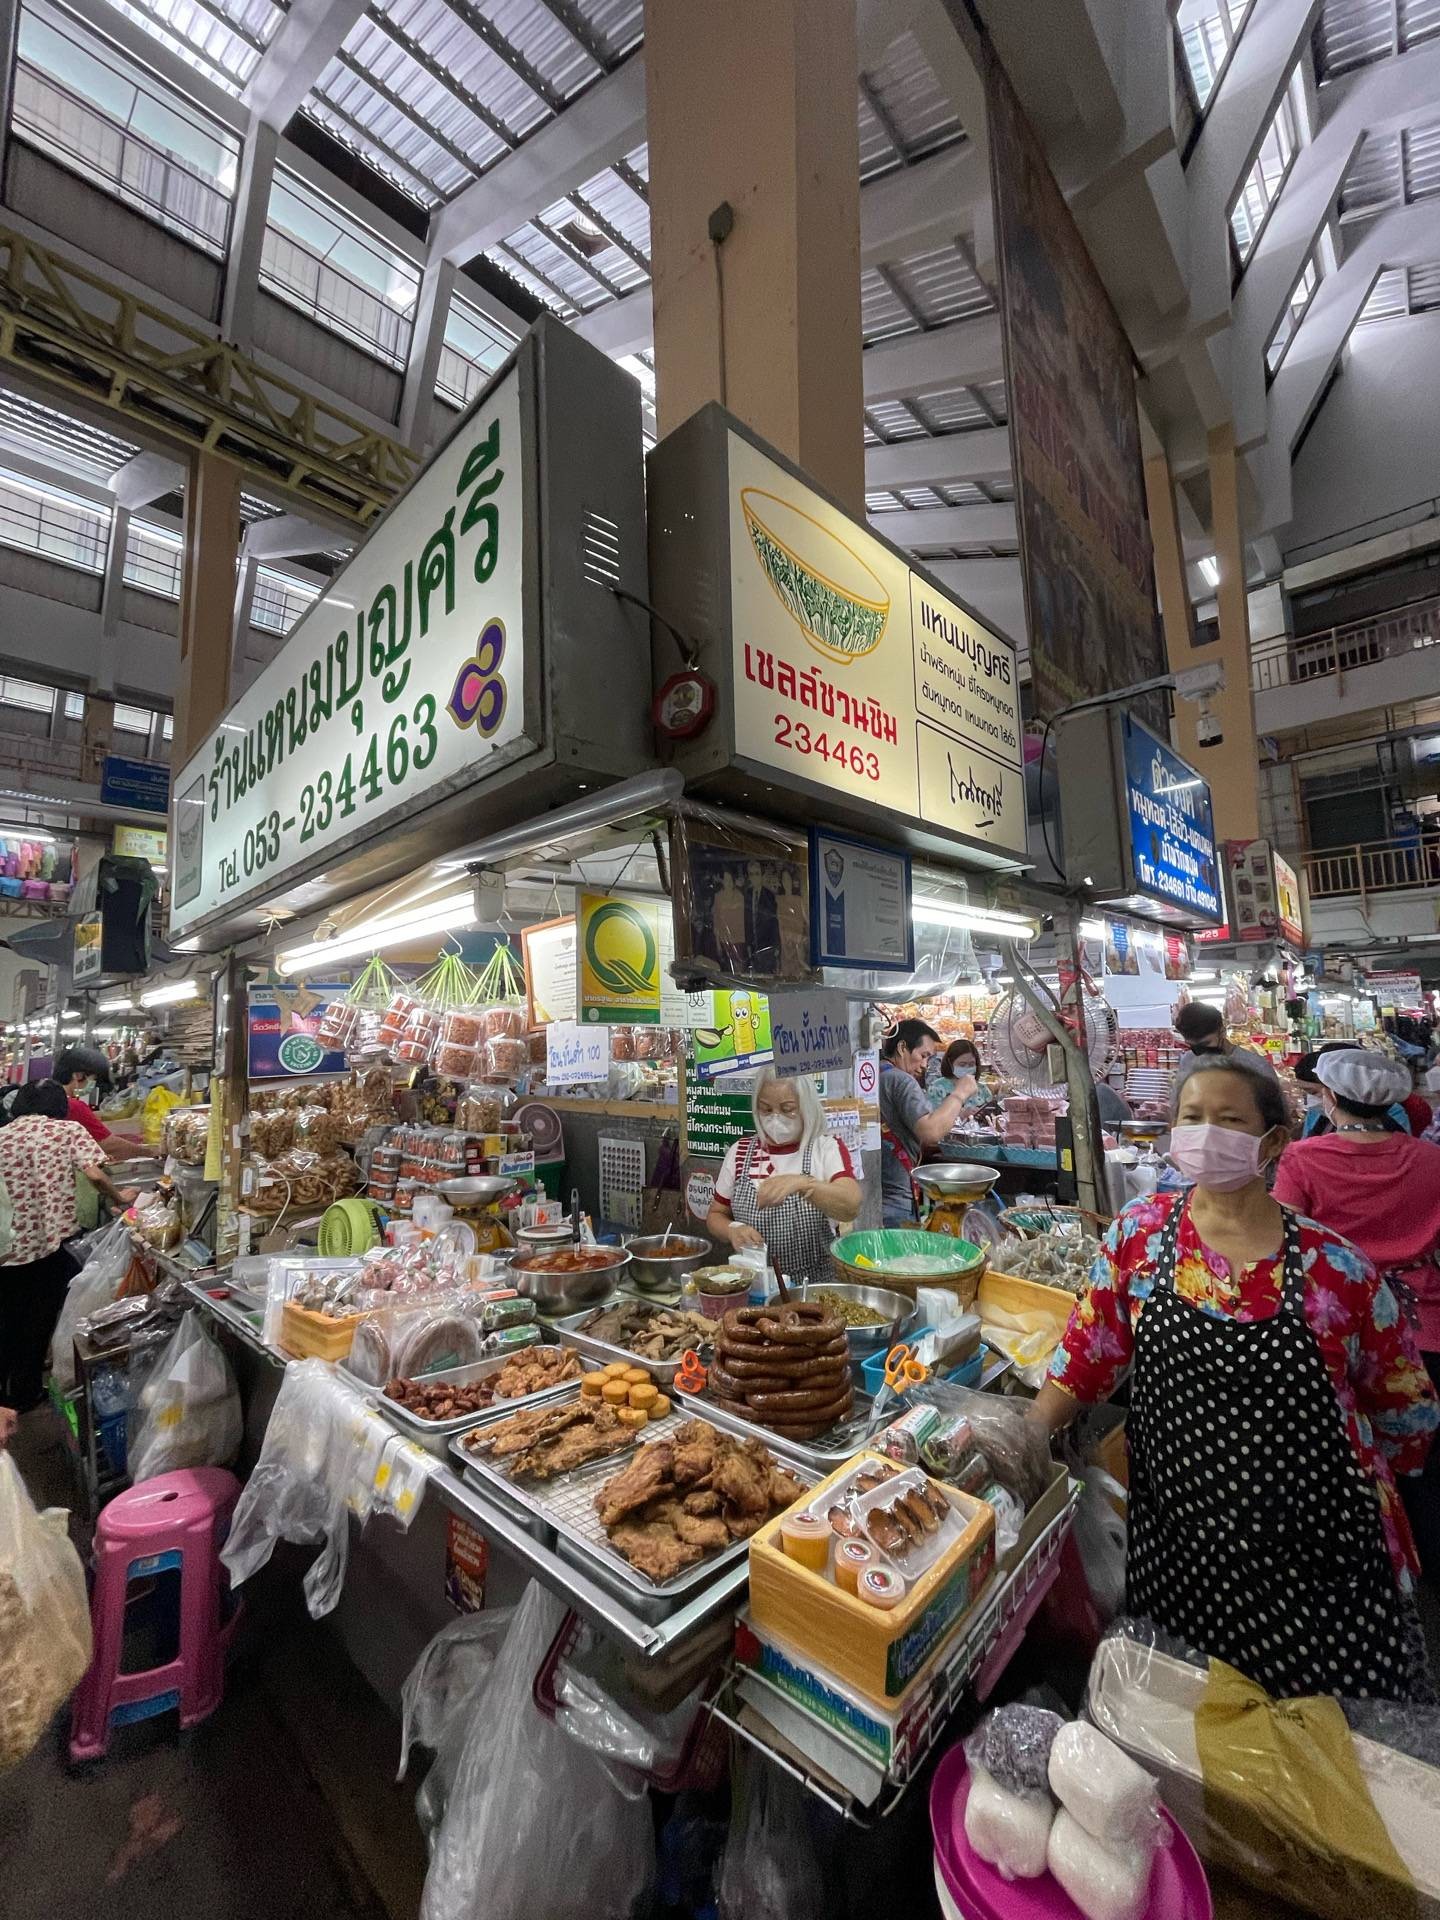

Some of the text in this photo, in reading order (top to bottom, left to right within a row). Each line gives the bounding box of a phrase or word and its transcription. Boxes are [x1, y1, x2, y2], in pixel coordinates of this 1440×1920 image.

[208, 419, 504, 823] ร้านแหนมบุญศรี
[921, 601, 1011, 685] แหนมบุญศรี
[745, 642, 898, 747] เชลล์ชวนชิม
[219, 695, 438, 893] Tel. 053-234463
[774, 714, 881, 782] 234463
[588, 1045, 601, 1061] 100
